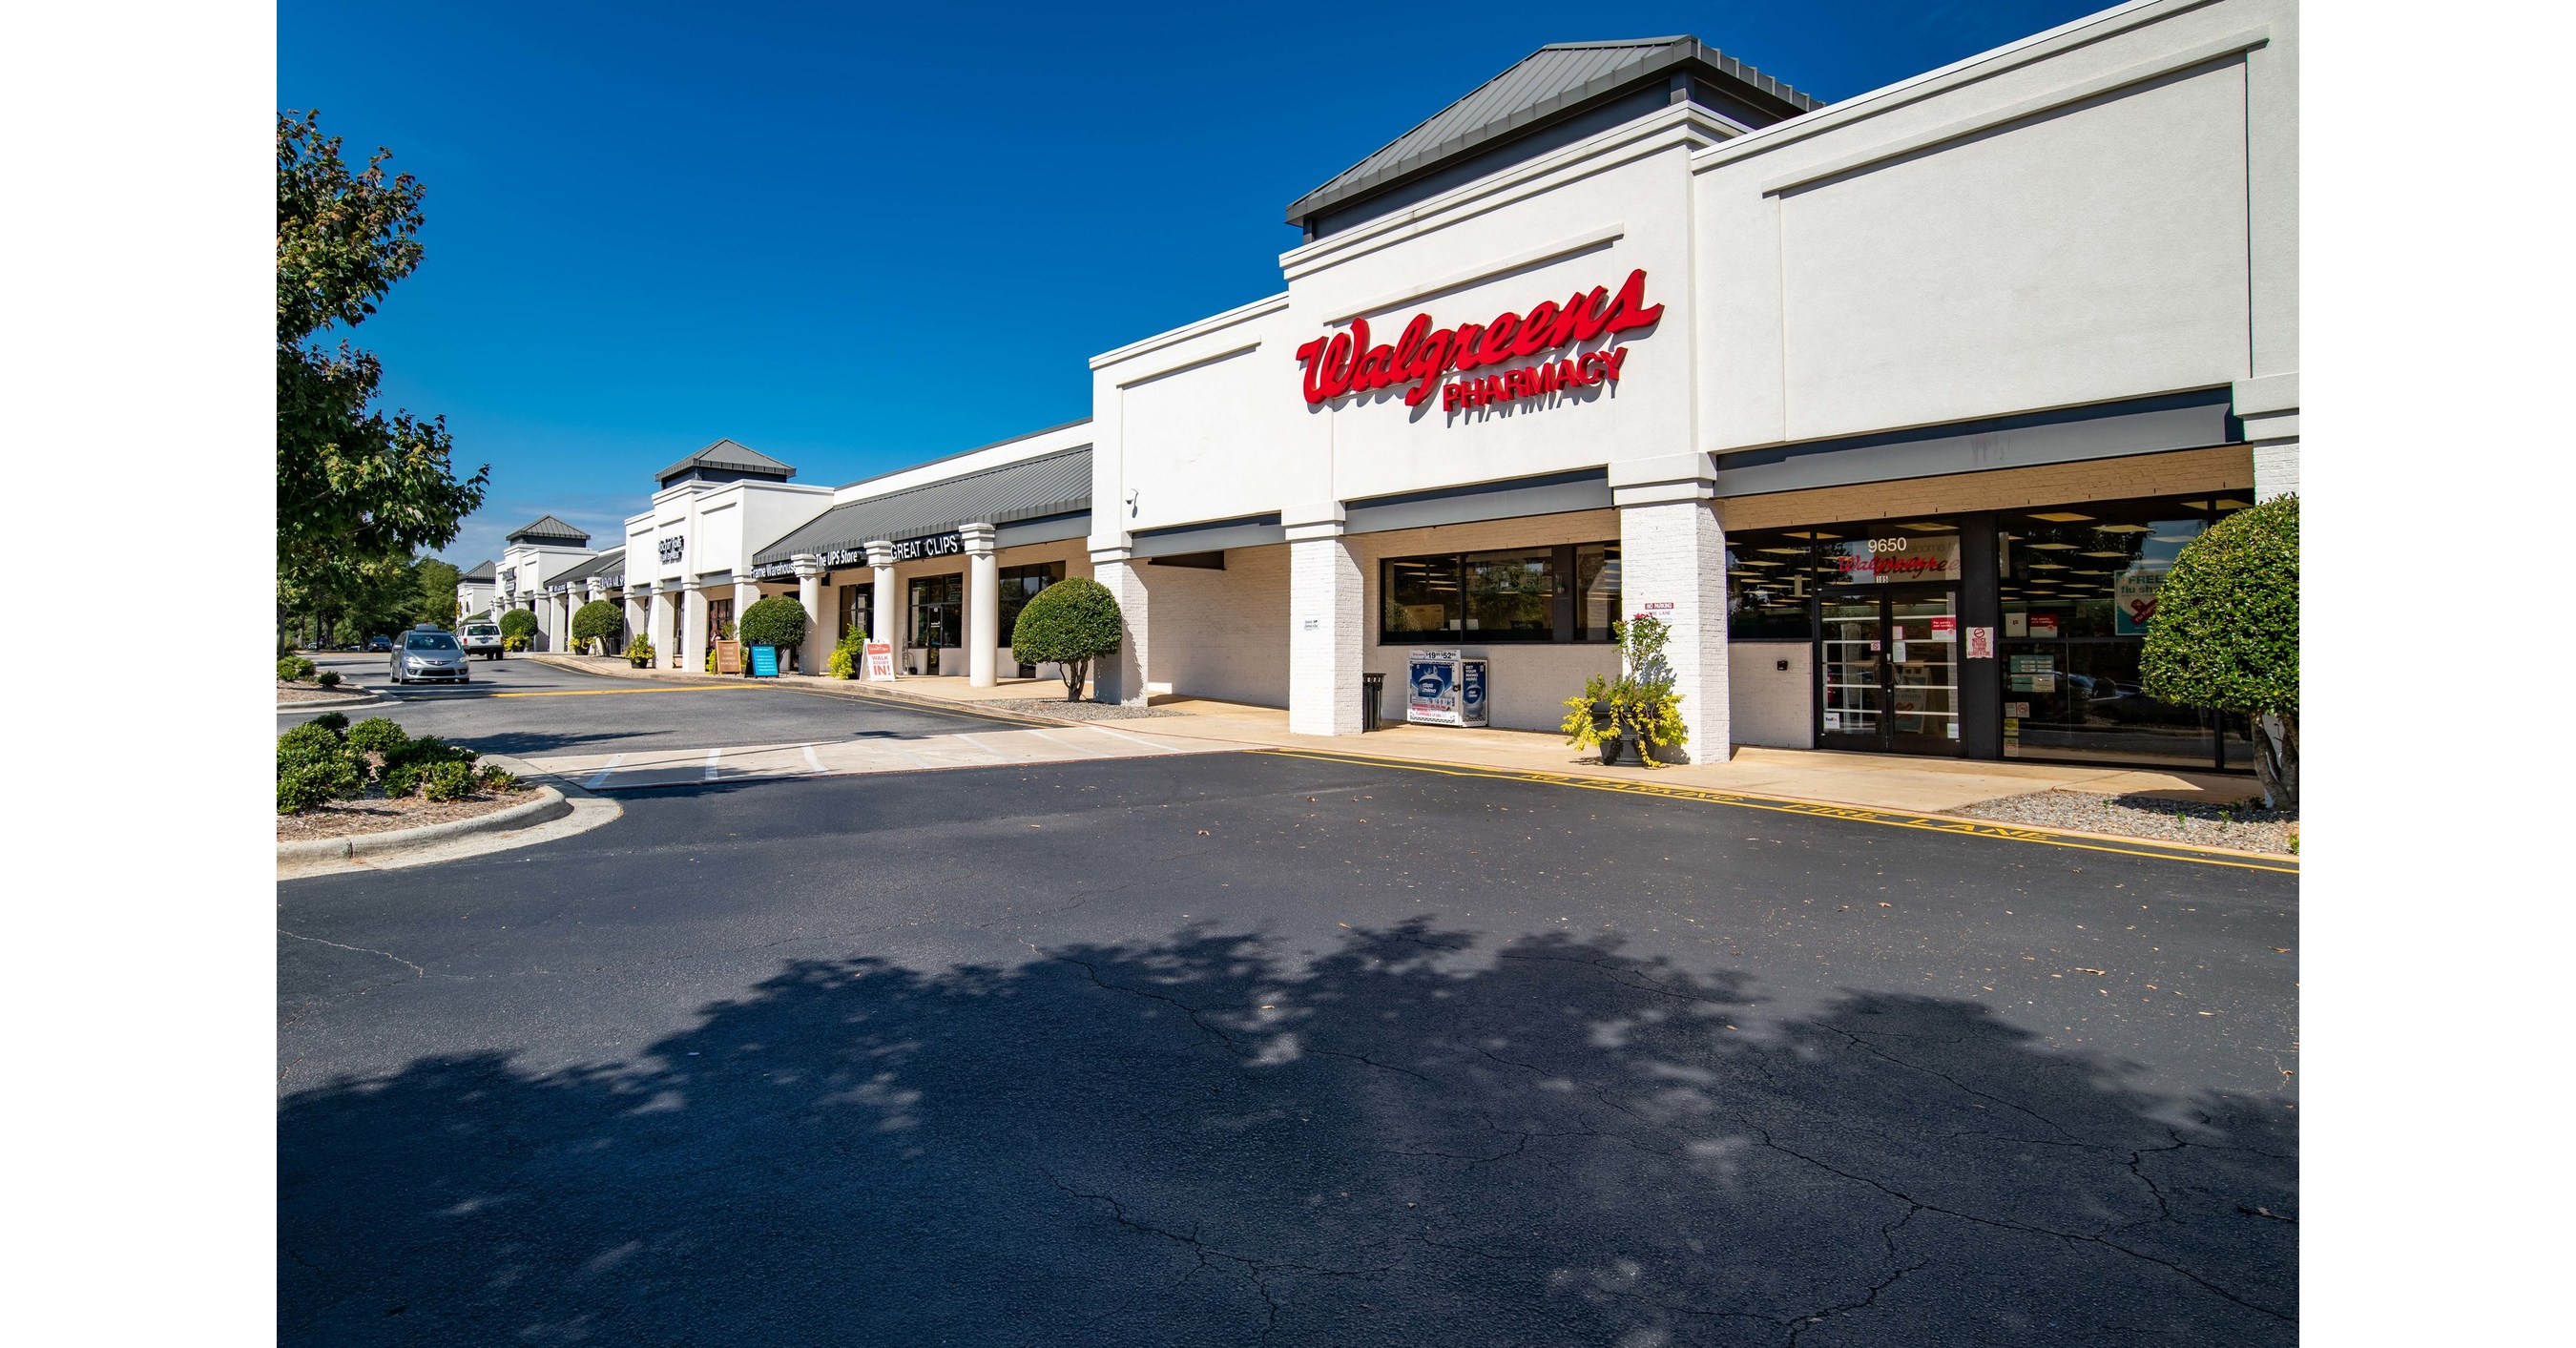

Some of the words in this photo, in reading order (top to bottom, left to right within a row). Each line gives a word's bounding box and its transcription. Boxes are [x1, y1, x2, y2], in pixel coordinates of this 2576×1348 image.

[1296, 268, 1665, 406] Walgreens
[1443, 347, 1628, 412] PHARMACY
[890, 540, 921, 561] GREAT
[925, 534, 958, 556] CLIPS
[1868, 537, 1907, 553] 9650
[816, 553, 827, 568] The
[827, 550, 840, 566] UPS
[841, 549, 858, 564] Store
[750, 566, 766, 579] Frame
[766, 561, 797, 577] Warehous
[2129, 574, 2164, 585] FREE
[2121, 585, 2136, 593] flu
[873, 665, 891, 675] IN!
[1780, 803, 1892, 819] FIRE
[1906, 818, 2060, 841] LANE
